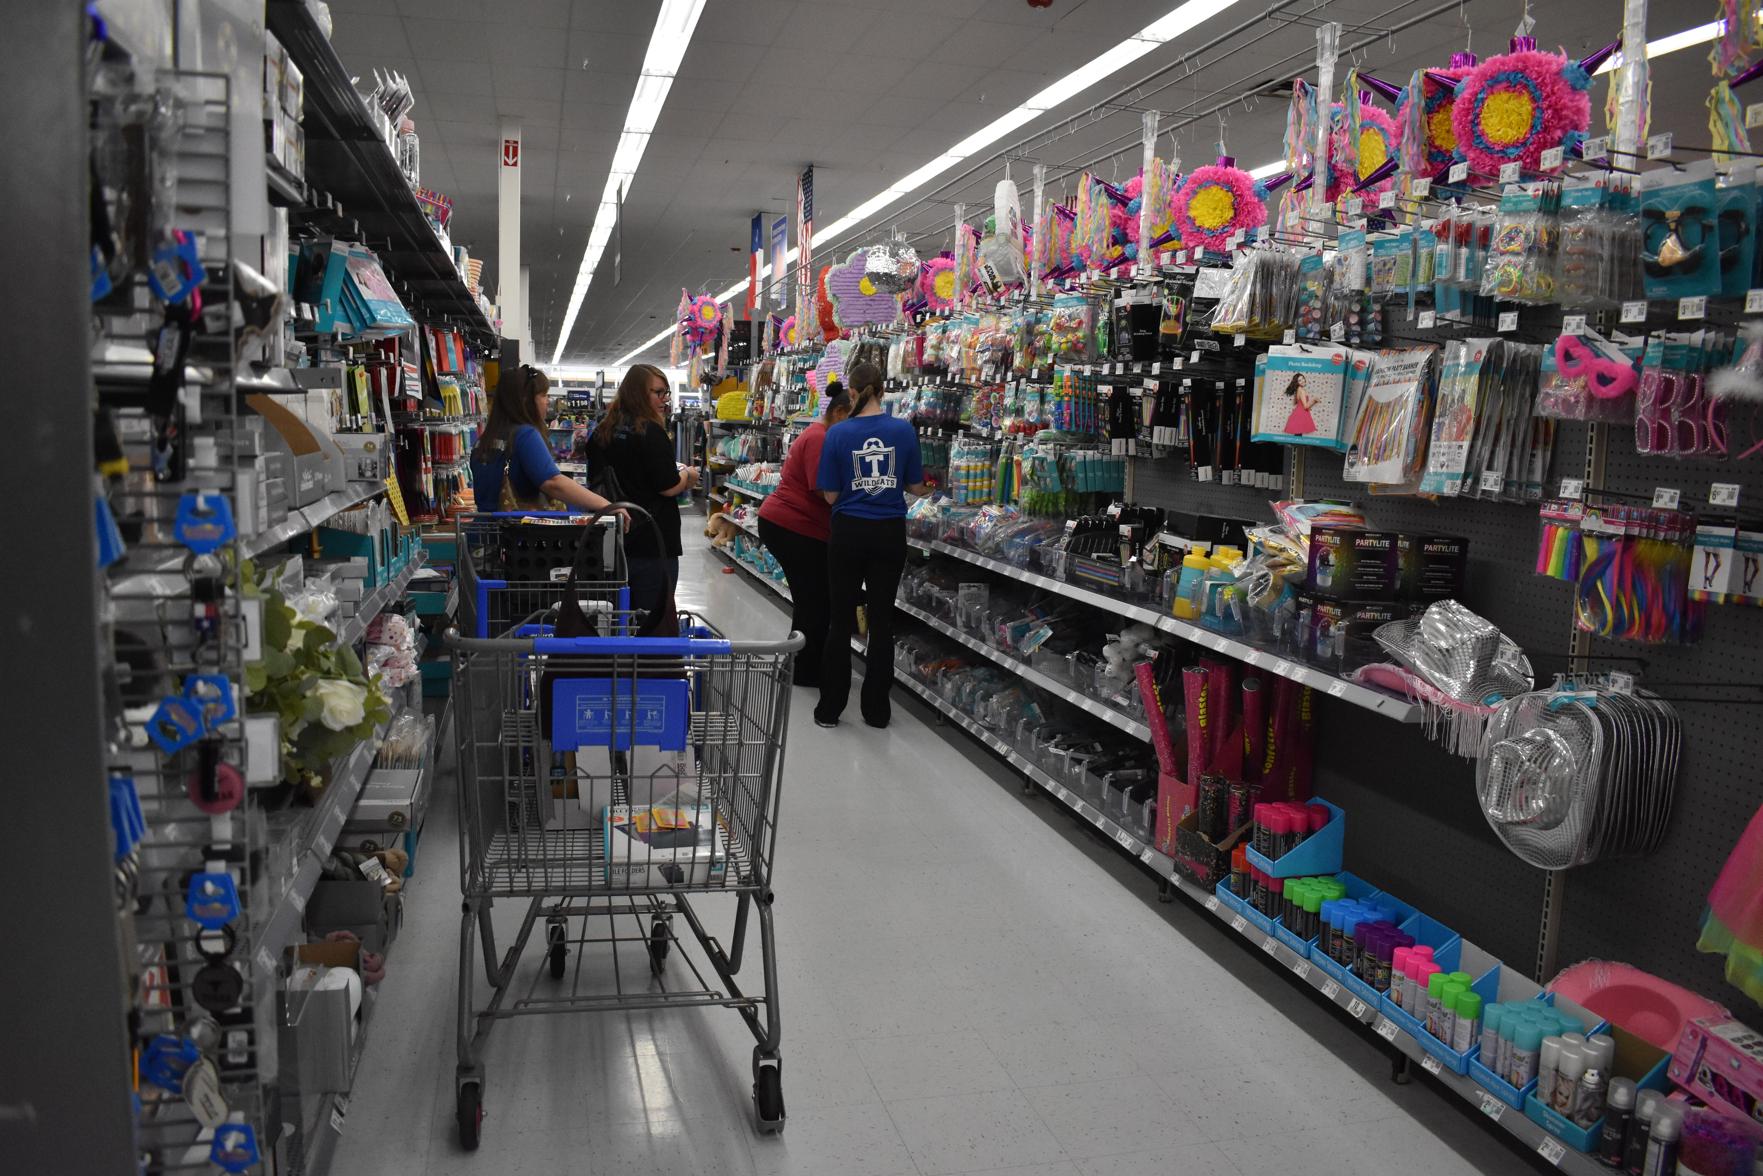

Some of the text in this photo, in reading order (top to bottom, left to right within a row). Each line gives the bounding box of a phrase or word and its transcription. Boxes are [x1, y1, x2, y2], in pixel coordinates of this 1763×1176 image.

[865, 455, 884, 477] T
[854, 479, 896, 489] WILDCATS
[1315, 534, 1341, 545] PARTYLITE
[1355, 538, 1390, 548] PARTYLITE
[1423, 544, 1460, 553] PARTYLITE
[1317, 604, 1342, 616] PARTYLITE
[1356, 611, 1392, 621] PARTYLITE
[621, 867, 646, 875] FODERS
